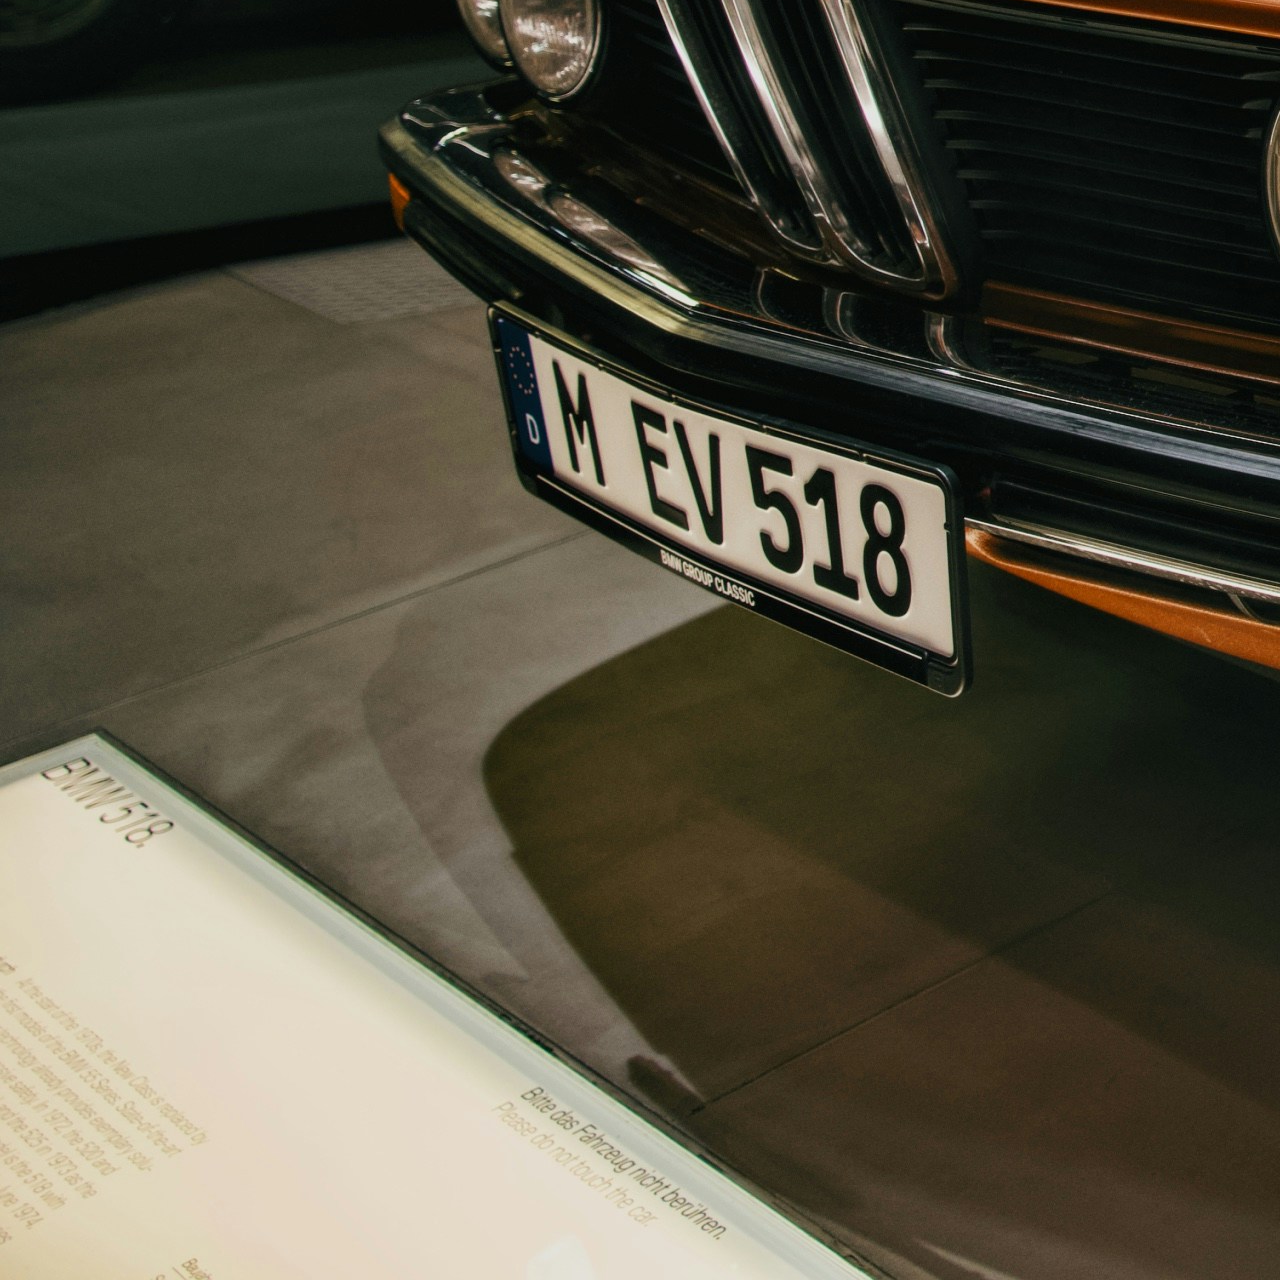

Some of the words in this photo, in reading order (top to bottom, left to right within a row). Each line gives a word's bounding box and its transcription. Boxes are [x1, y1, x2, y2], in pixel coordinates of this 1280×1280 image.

[525, 412, 541, 445] D
[552, 358, 606, 487] M
[631, 399, 724, 546] EV
[745, 444, 912, 619] 518
[660, 549, 682, 573] BMW
[682, 561, 714, 588] GROUP
[714, 576, 756, 607] CLASSIC
[41, 756, 134, 810] BMW
[99, 801, 174, 848] 518.
[492, 1101, 537, 1138] Please
[530, 1132, 556, 1150] do
[549, 1145, 579, 1167] not
[569, 1160, 613, 1193] touch
[603, 1186, 634, 1209] the
[627, 1204, 659, 1228] car.
[520, 1086, 556, 1114] Bitte
[549, 1107, 580, 1131] das
[572, 1123, 636, 1173] Fahrzeug
[629, 1165, 672, 1196] nicht
[660, 1187, 727, 1240] berühren.
